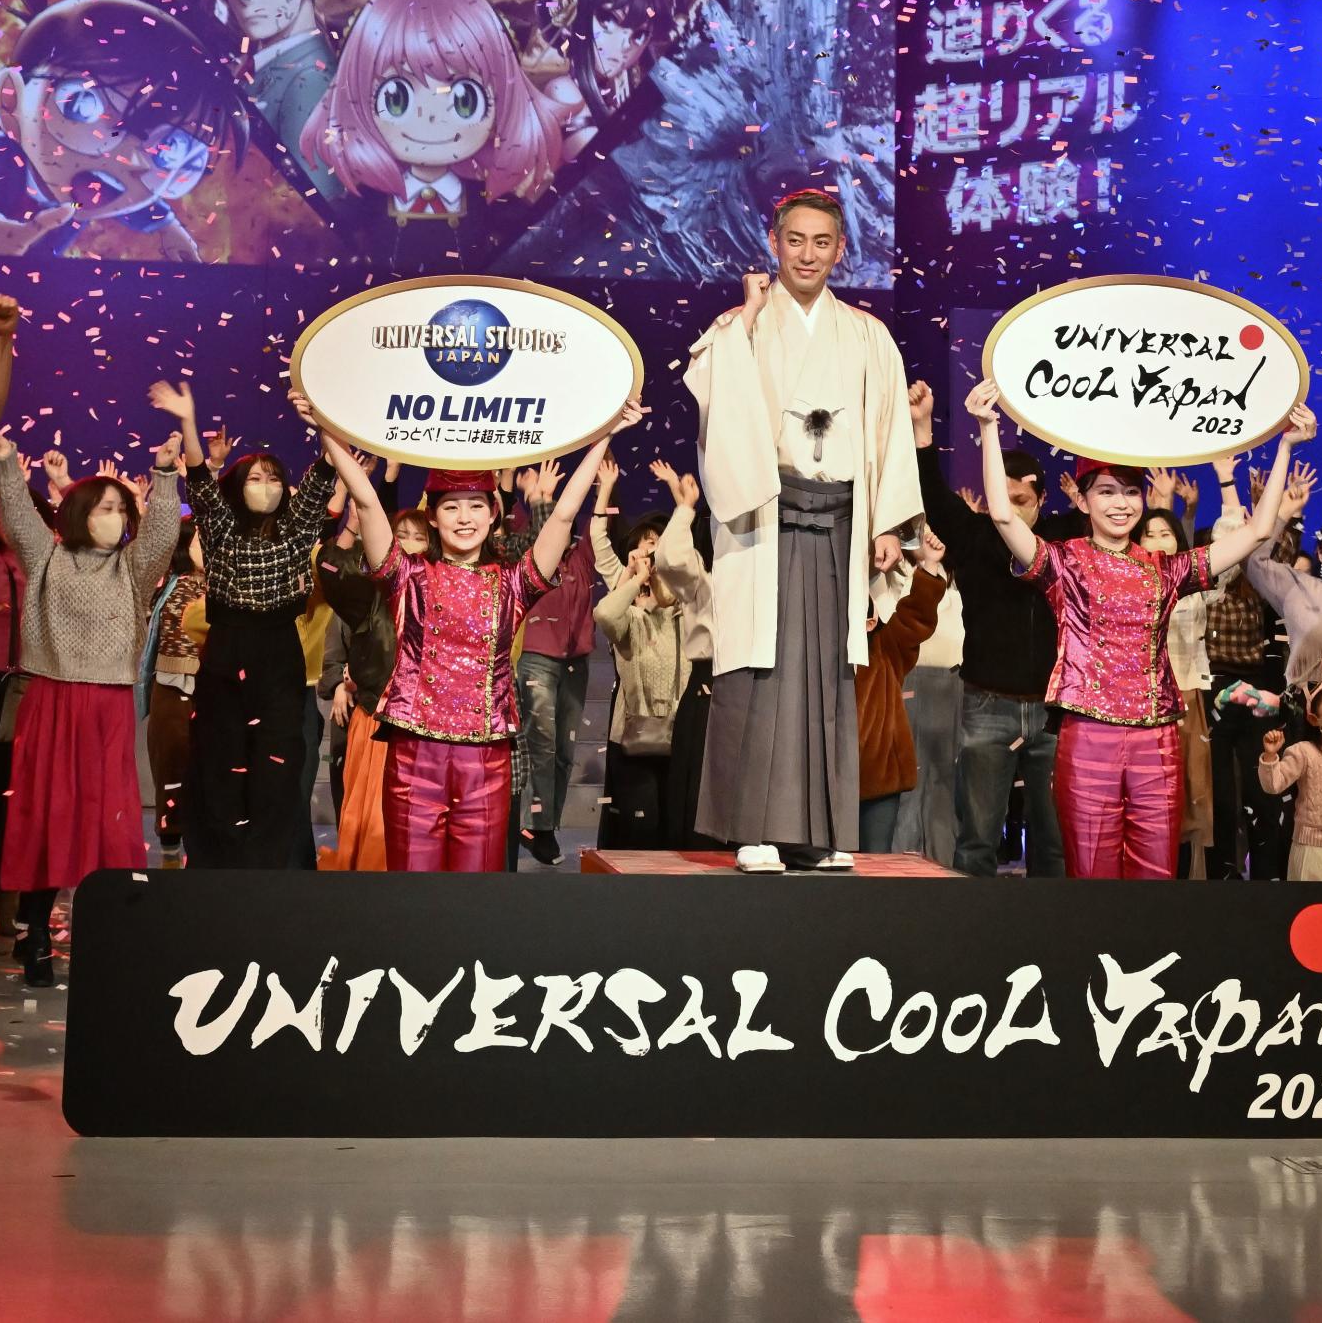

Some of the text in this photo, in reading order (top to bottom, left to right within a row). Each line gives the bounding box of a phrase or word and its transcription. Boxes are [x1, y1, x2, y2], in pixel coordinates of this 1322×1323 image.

[911, 71, 1138, 157] 超リアル
[372, 324, 567, 354] UNIVERSAL STUDIOS
[1054, 324, 1235, 361] UNIVERSAL
[435, 350, 500, 365] JAPAN
[1025, 359, 1119, 401] COOL
[386, 394, 546, 424] NO LIMIT!
[1191, 415, 1244, 436] 2023
[168, 955, 795, 1061] UNIVERSAL
[823, 956, 1061, 1063] COOL
